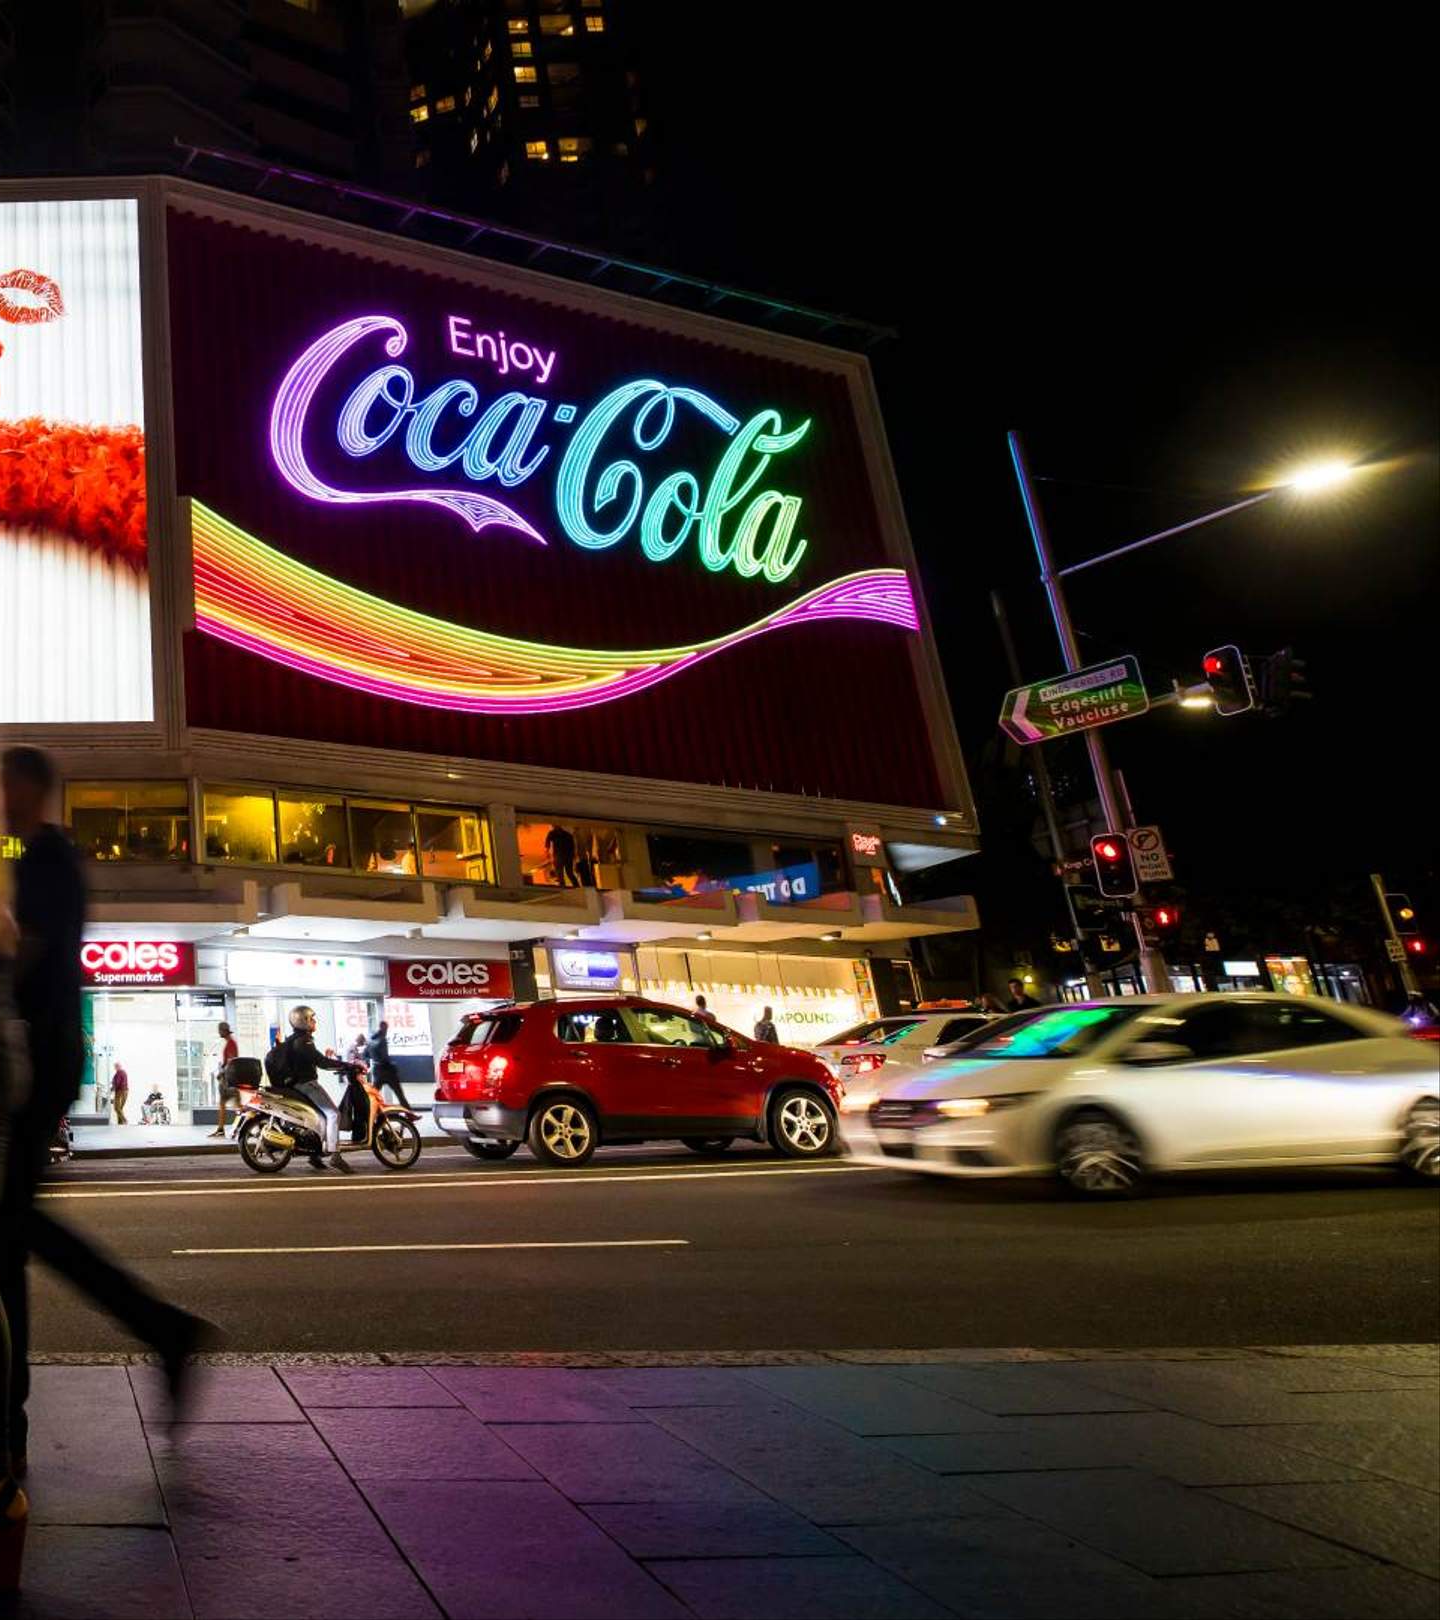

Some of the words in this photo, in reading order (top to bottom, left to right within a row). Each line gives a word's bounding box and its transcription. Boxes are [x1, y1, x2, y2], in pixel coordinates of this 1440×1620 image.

[447, 315, 557, 383] Enjoy
[270, 315, 812, 584] Coca-Cola
[1049, 684, 1124, 715] Edgecliff
[1053, 701, 1129, 730] Vaucluse
[1140, 852, 1160, 862] NO
[80, 941, 179, 970] coles
[93, 971, 165, 985] Supermarket
[406, 961, 490, 985] coles
[418, 986, 478, 997] Supermarket
